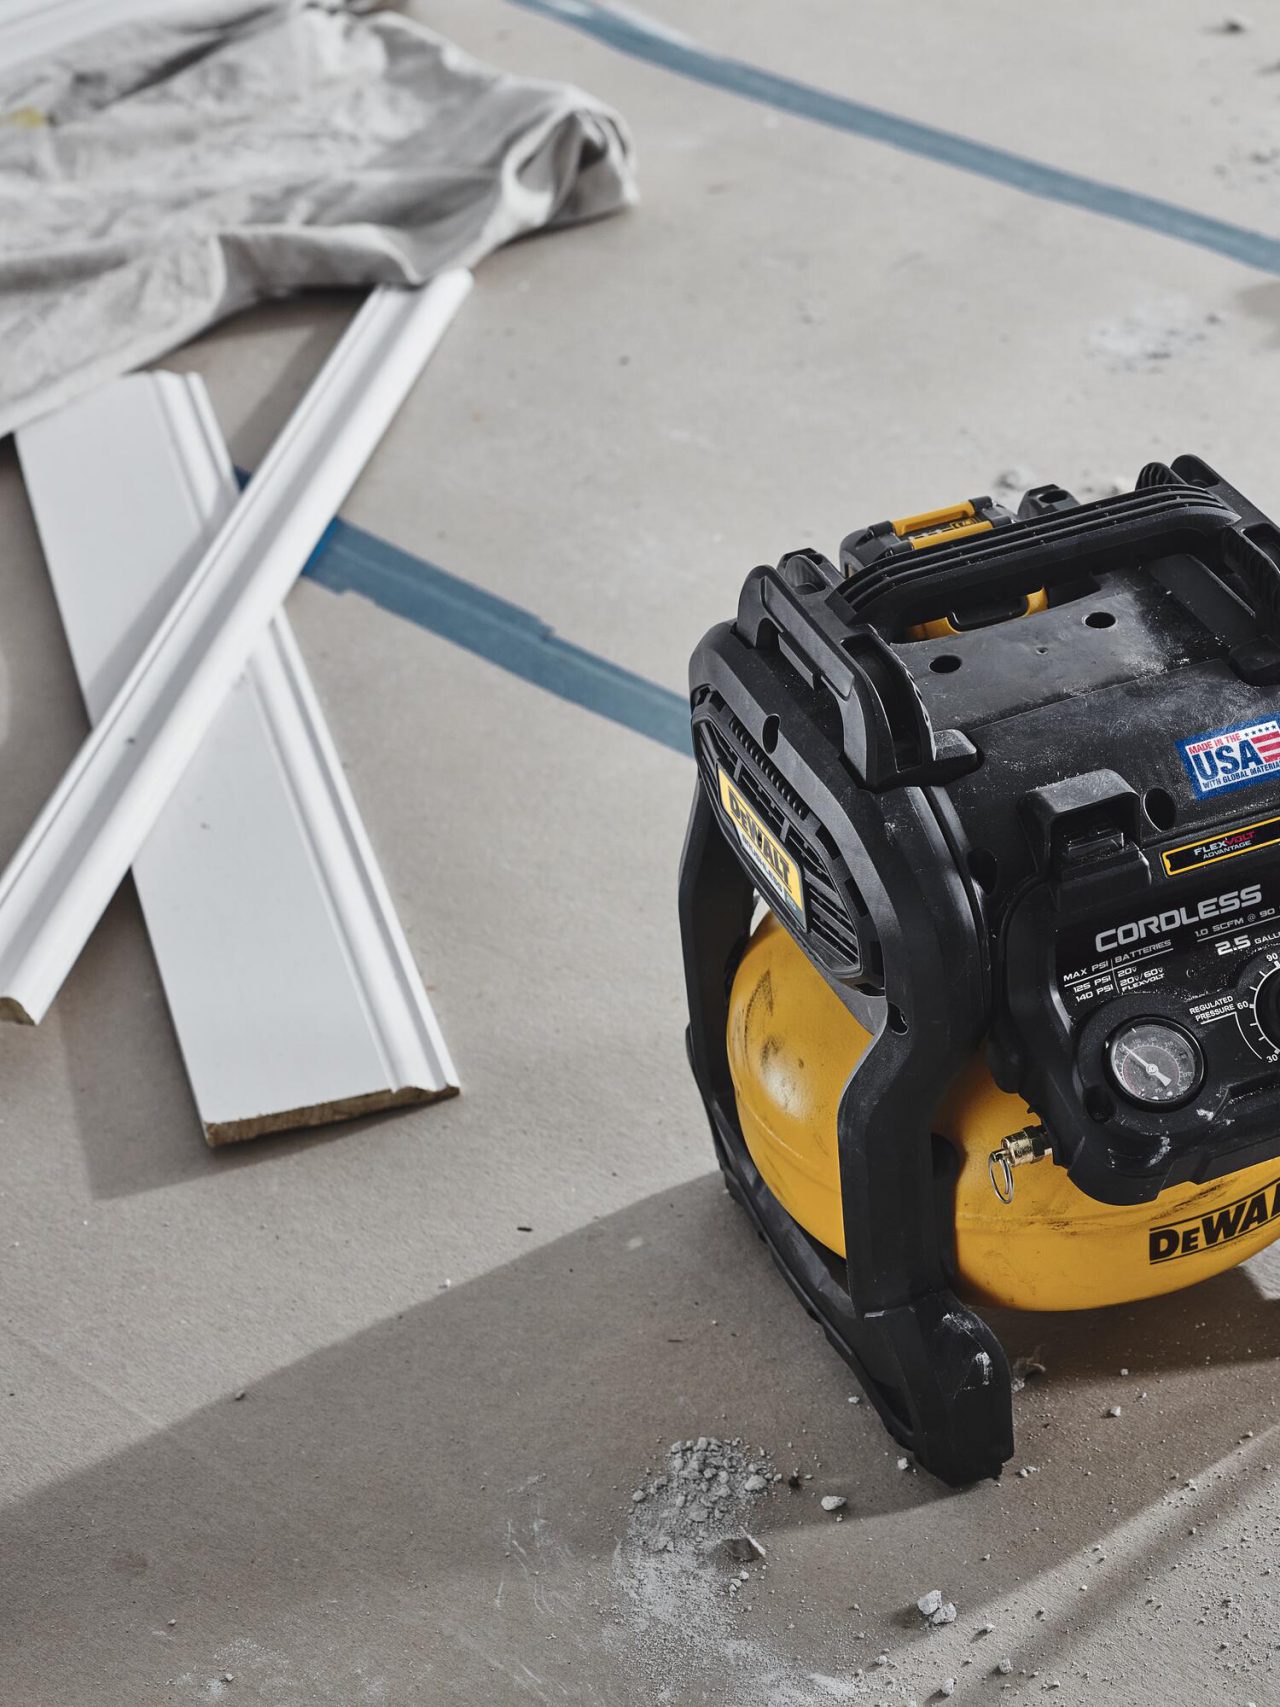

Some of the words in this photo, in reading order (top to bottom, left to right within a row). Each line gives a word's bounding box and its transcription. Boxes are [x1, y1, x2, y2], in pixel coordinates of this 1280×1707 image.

[1188, 741, 1213, 755] MADE
[1215, 738, 1224, 747] IN
[1224, 733, 1241, 744] THE
[1191, 739, 1264, 781] USA
[1202, 777, 1222, 789] WITH
[1223, 770, 1248, 783] GLOBAL
[1193, 831, 1256, 856] FLEXVOLT
[1203, 840, 1252, 859] ADVANTAGE
[1095, 884, 1262, 953] CORDLESS
[1194, 928, 1209, 938] 1.0
[1212, 917, 1245, 932] SCFM
[1247, 913, 1256, 922] @
[1259, 907, 1276, 918] 90
[1114, 939, 1172, 963] BATTERIES
[1215, 934, 1251, 956] 2.5
[1266, 952, 1279, 962] 90
[1063, 968, 1088, 982] MAX
[1091, 960, 1109, 972] PSI
[1073, 982, 1091, 993] 125
[1094, 975, 1111, 986] PSI
[1121, 973, 1165, 992] FLEXVOLT
[1076, 991, 1094, 1002] 140
[1096, 984, 1114, 995] PSI
[1189, 995, 1234, 1015] REGULATED
[1195, 1003, 1236, 1022] PRESSURE
[1237, 1000, 1249, 1011] 60
[1266, 1053, 1279, 1063] 30
